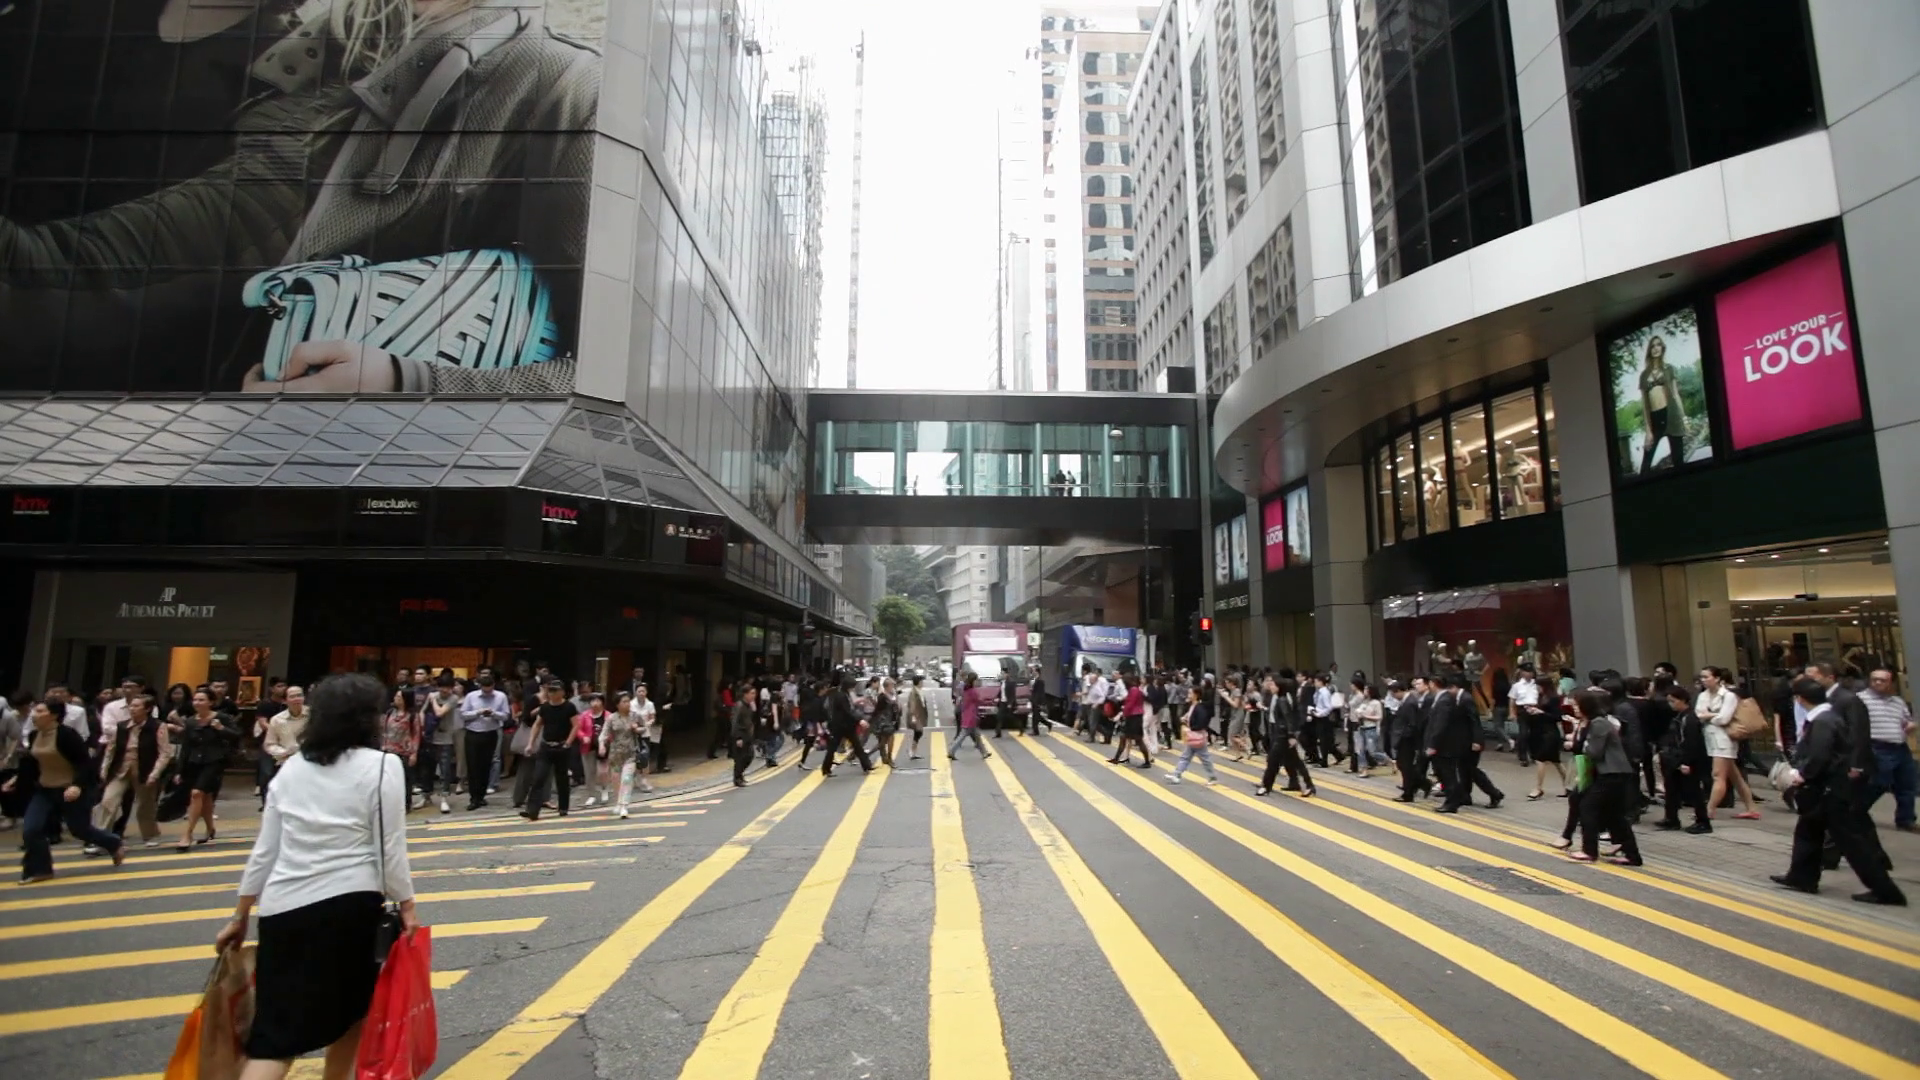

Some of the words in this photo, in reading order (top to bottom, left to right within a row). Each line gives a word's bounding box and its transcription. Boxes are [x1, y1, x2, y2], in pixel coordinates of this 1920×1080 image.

[1756, 329, 1787, 348] LOVE
[1790, 314, 1826, 336] YOUR
[1744, 322, 1847, 382] LOOK
[14, 495, 50, 510] hmv
[541, 502, 579, 518] hmv
[159, 587, 177, 602] AP
[115, 603, 175, 618] AUDEMARS
[177, 603, 217, 618] PIGUET
